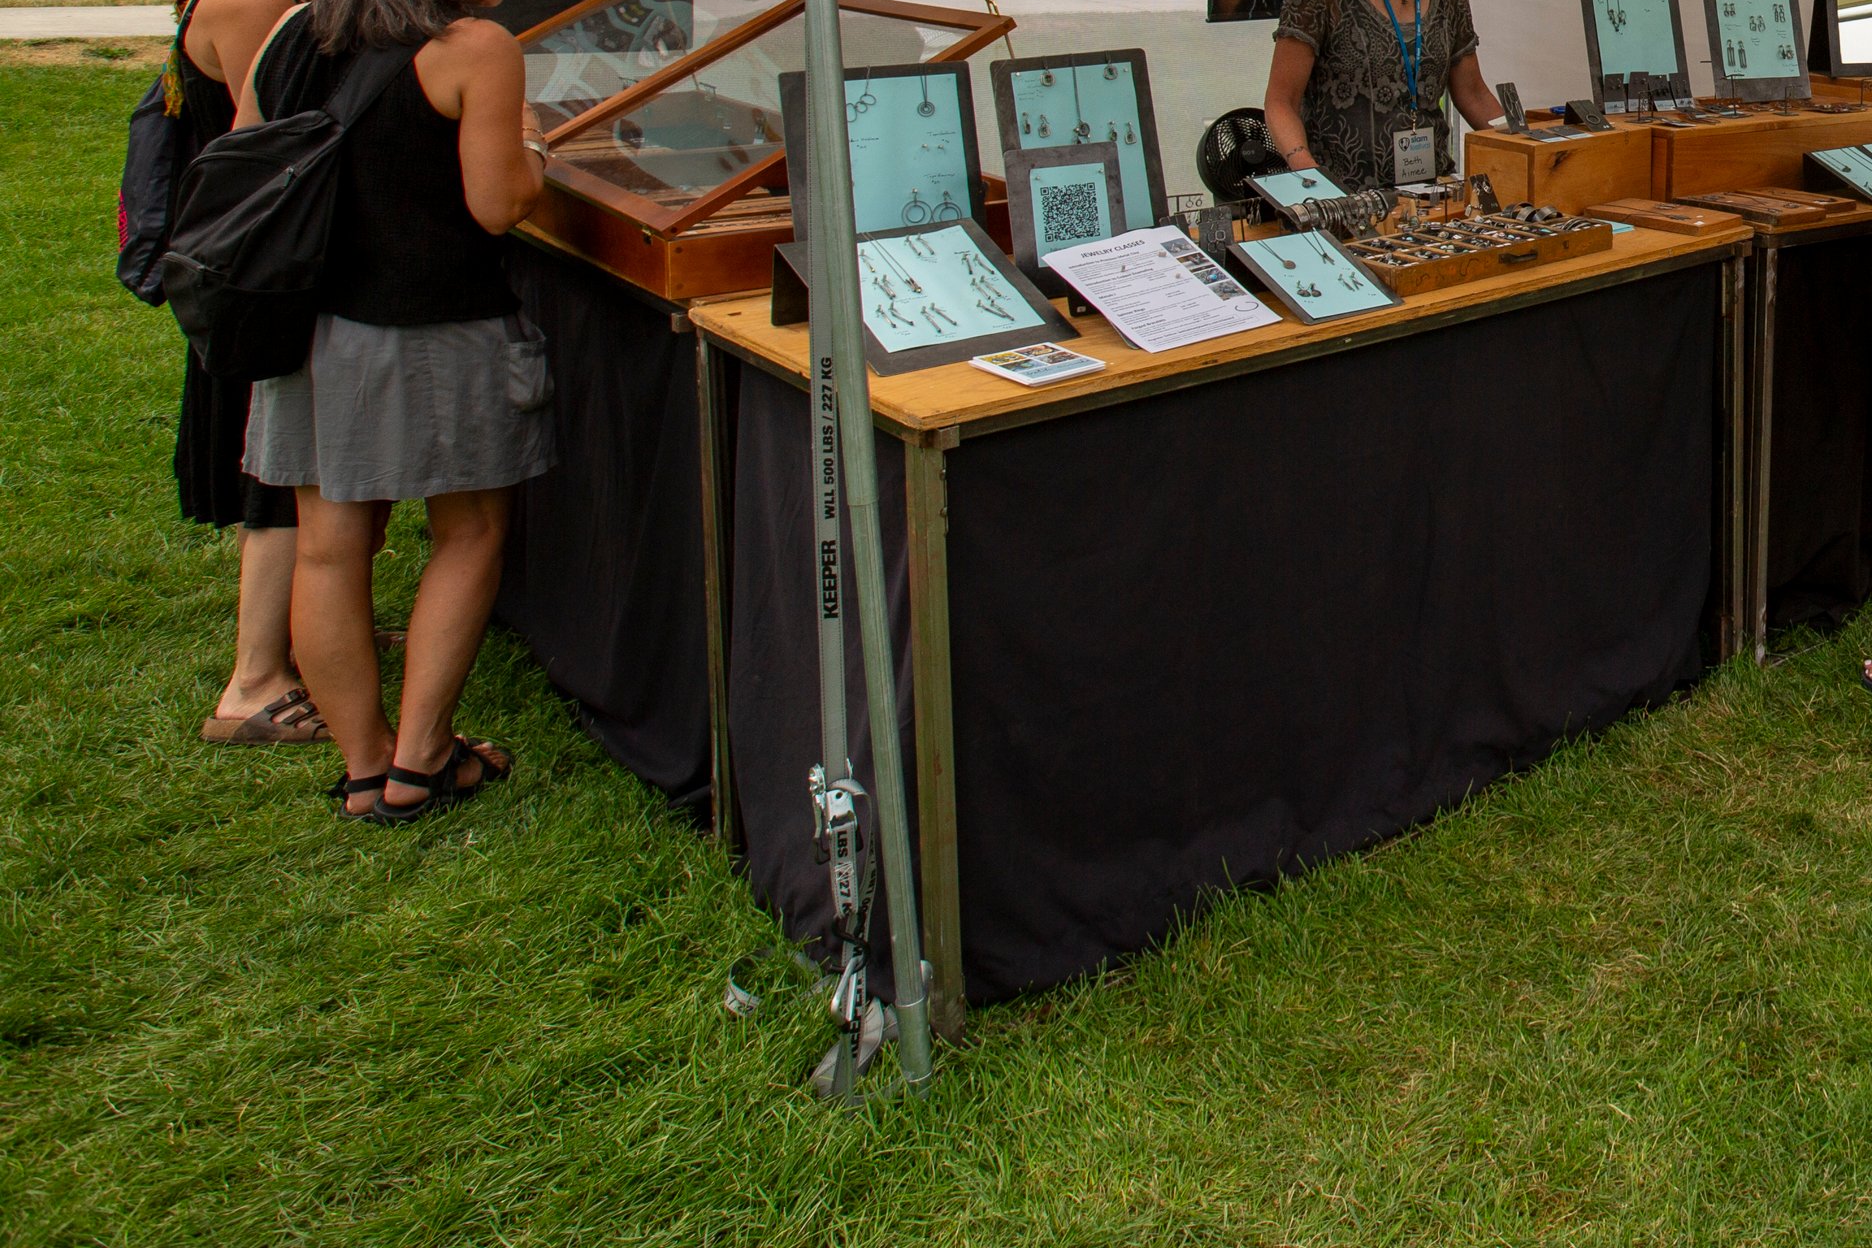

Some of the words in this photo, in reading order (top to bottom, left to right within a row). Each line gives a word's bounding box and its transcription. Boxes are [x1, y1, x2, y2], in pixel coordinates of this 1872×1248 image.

[1403, 156, 1422, 166] Beth
[1080, 247, 1113, 259] JEWELRY
[1114, 239, 1145, 251] CLASSES
[820, 357, 832, 380] KG
[821, 385, 833, 412] 227
[822, 427, 834, 453] LBS
[824, 457, 834, 485] 500
[824, 491, 836, 520] WLL
[821, 540, 839, 619] KEEPER
[837, 831, 848, 858] LBS
